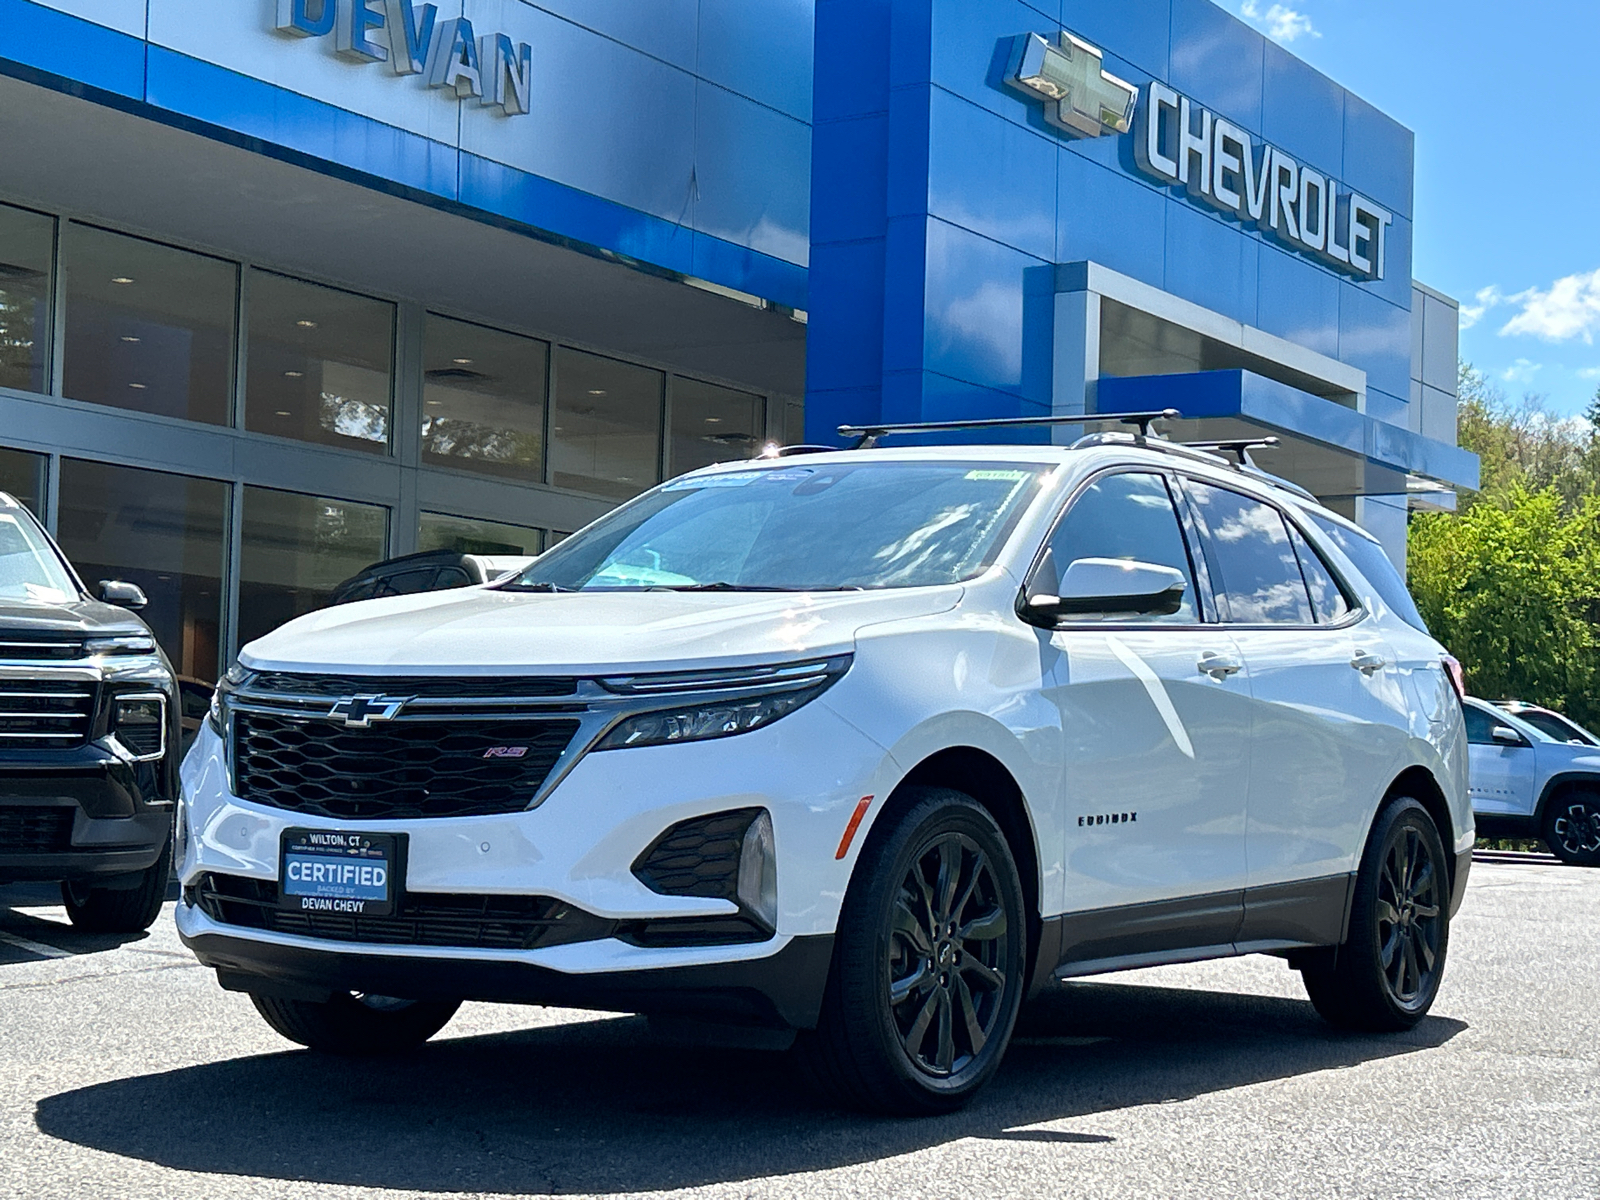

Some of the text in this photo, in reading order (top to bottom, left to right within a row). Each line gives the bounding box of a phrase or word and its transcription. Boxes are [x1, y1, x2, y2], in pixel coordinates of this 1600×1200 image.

[1143, 81, 1392, 281] CHEVROLET
[483, 746, 528, 758] RS
[1078, 812, 1137, 827] EQUINOX
[348, 835, 361, 847] CT
[288, 861, 387, 887] CERTIFIED
[302, 897, 365, 913] DEVAN CHEVY
